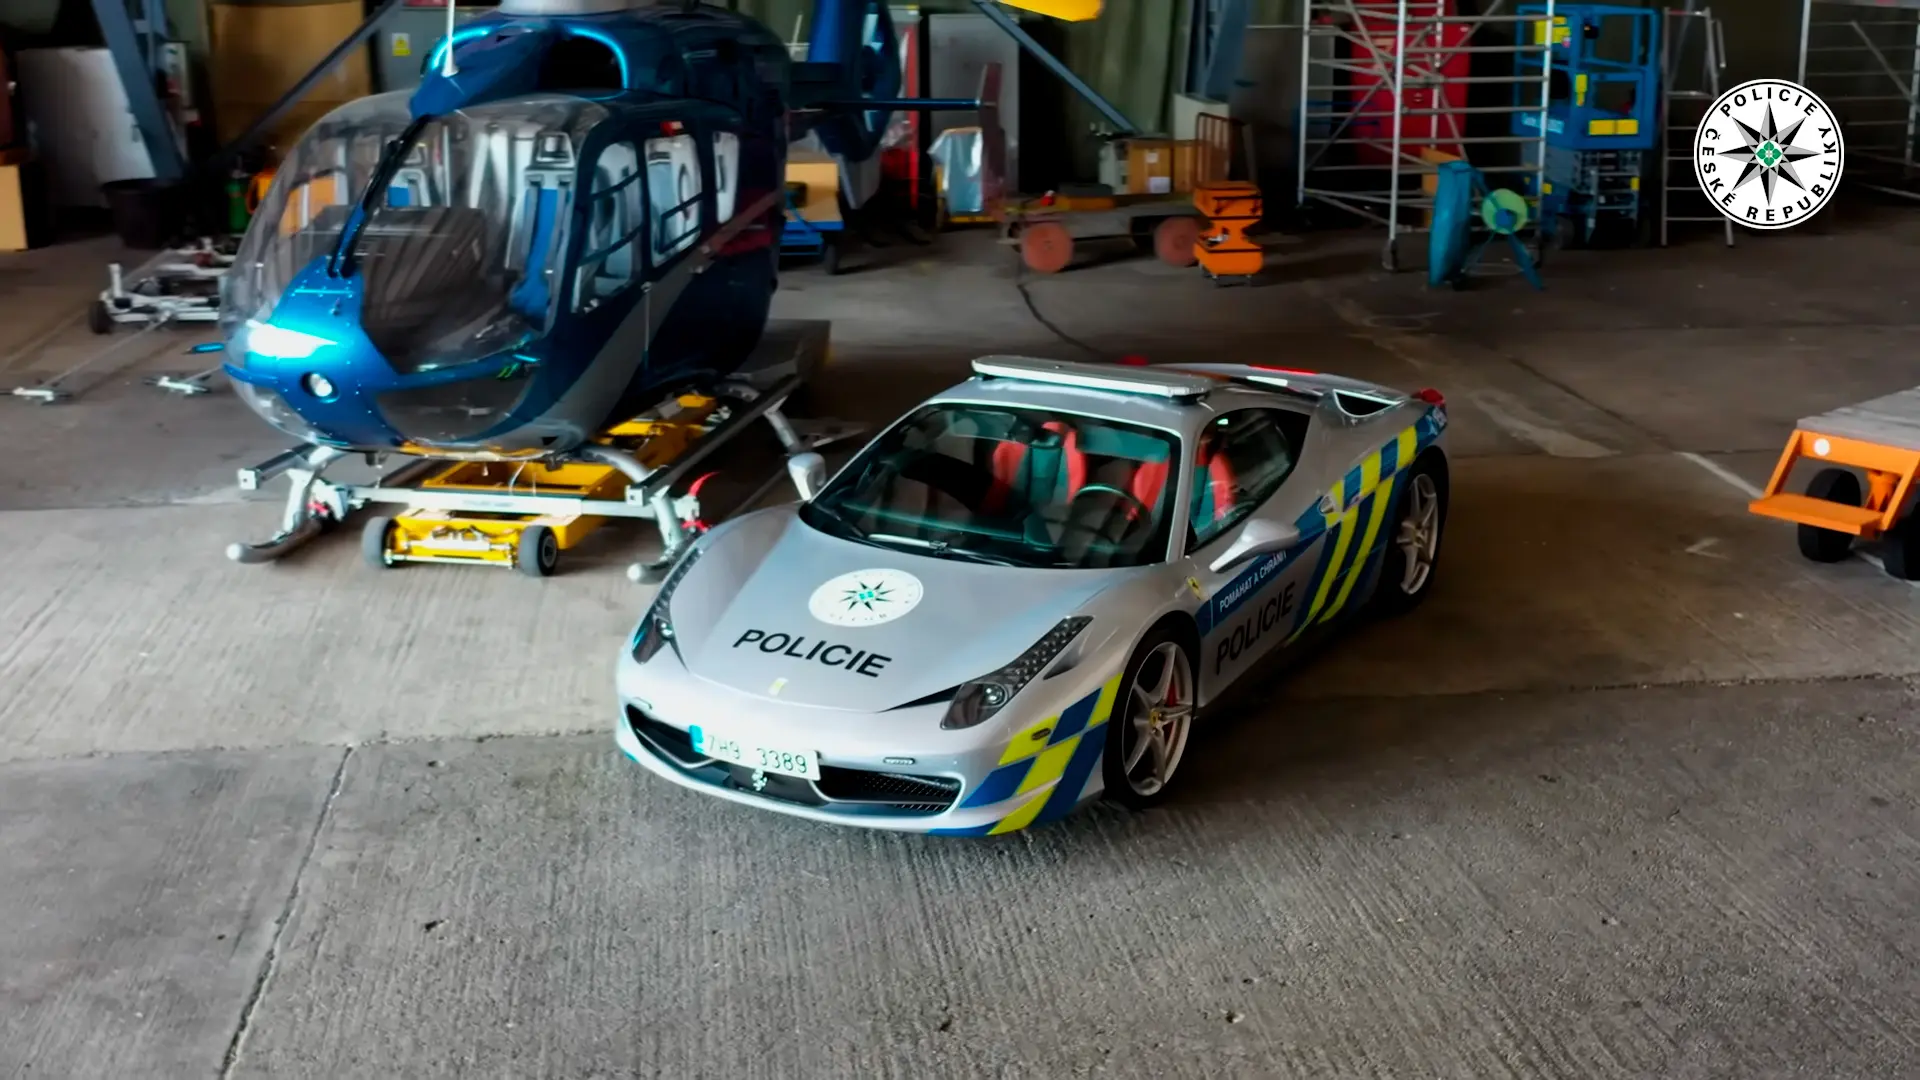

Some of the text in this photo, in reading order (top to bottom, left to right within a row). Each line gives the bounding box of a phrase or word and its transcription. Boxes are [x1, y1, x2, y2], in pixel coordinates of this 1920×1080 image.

[733, 628, 892, 678] POLICIE
[1216, 580, 1296, 676] POLICIE
[707, 734, 808, 774] 7H9 3389
